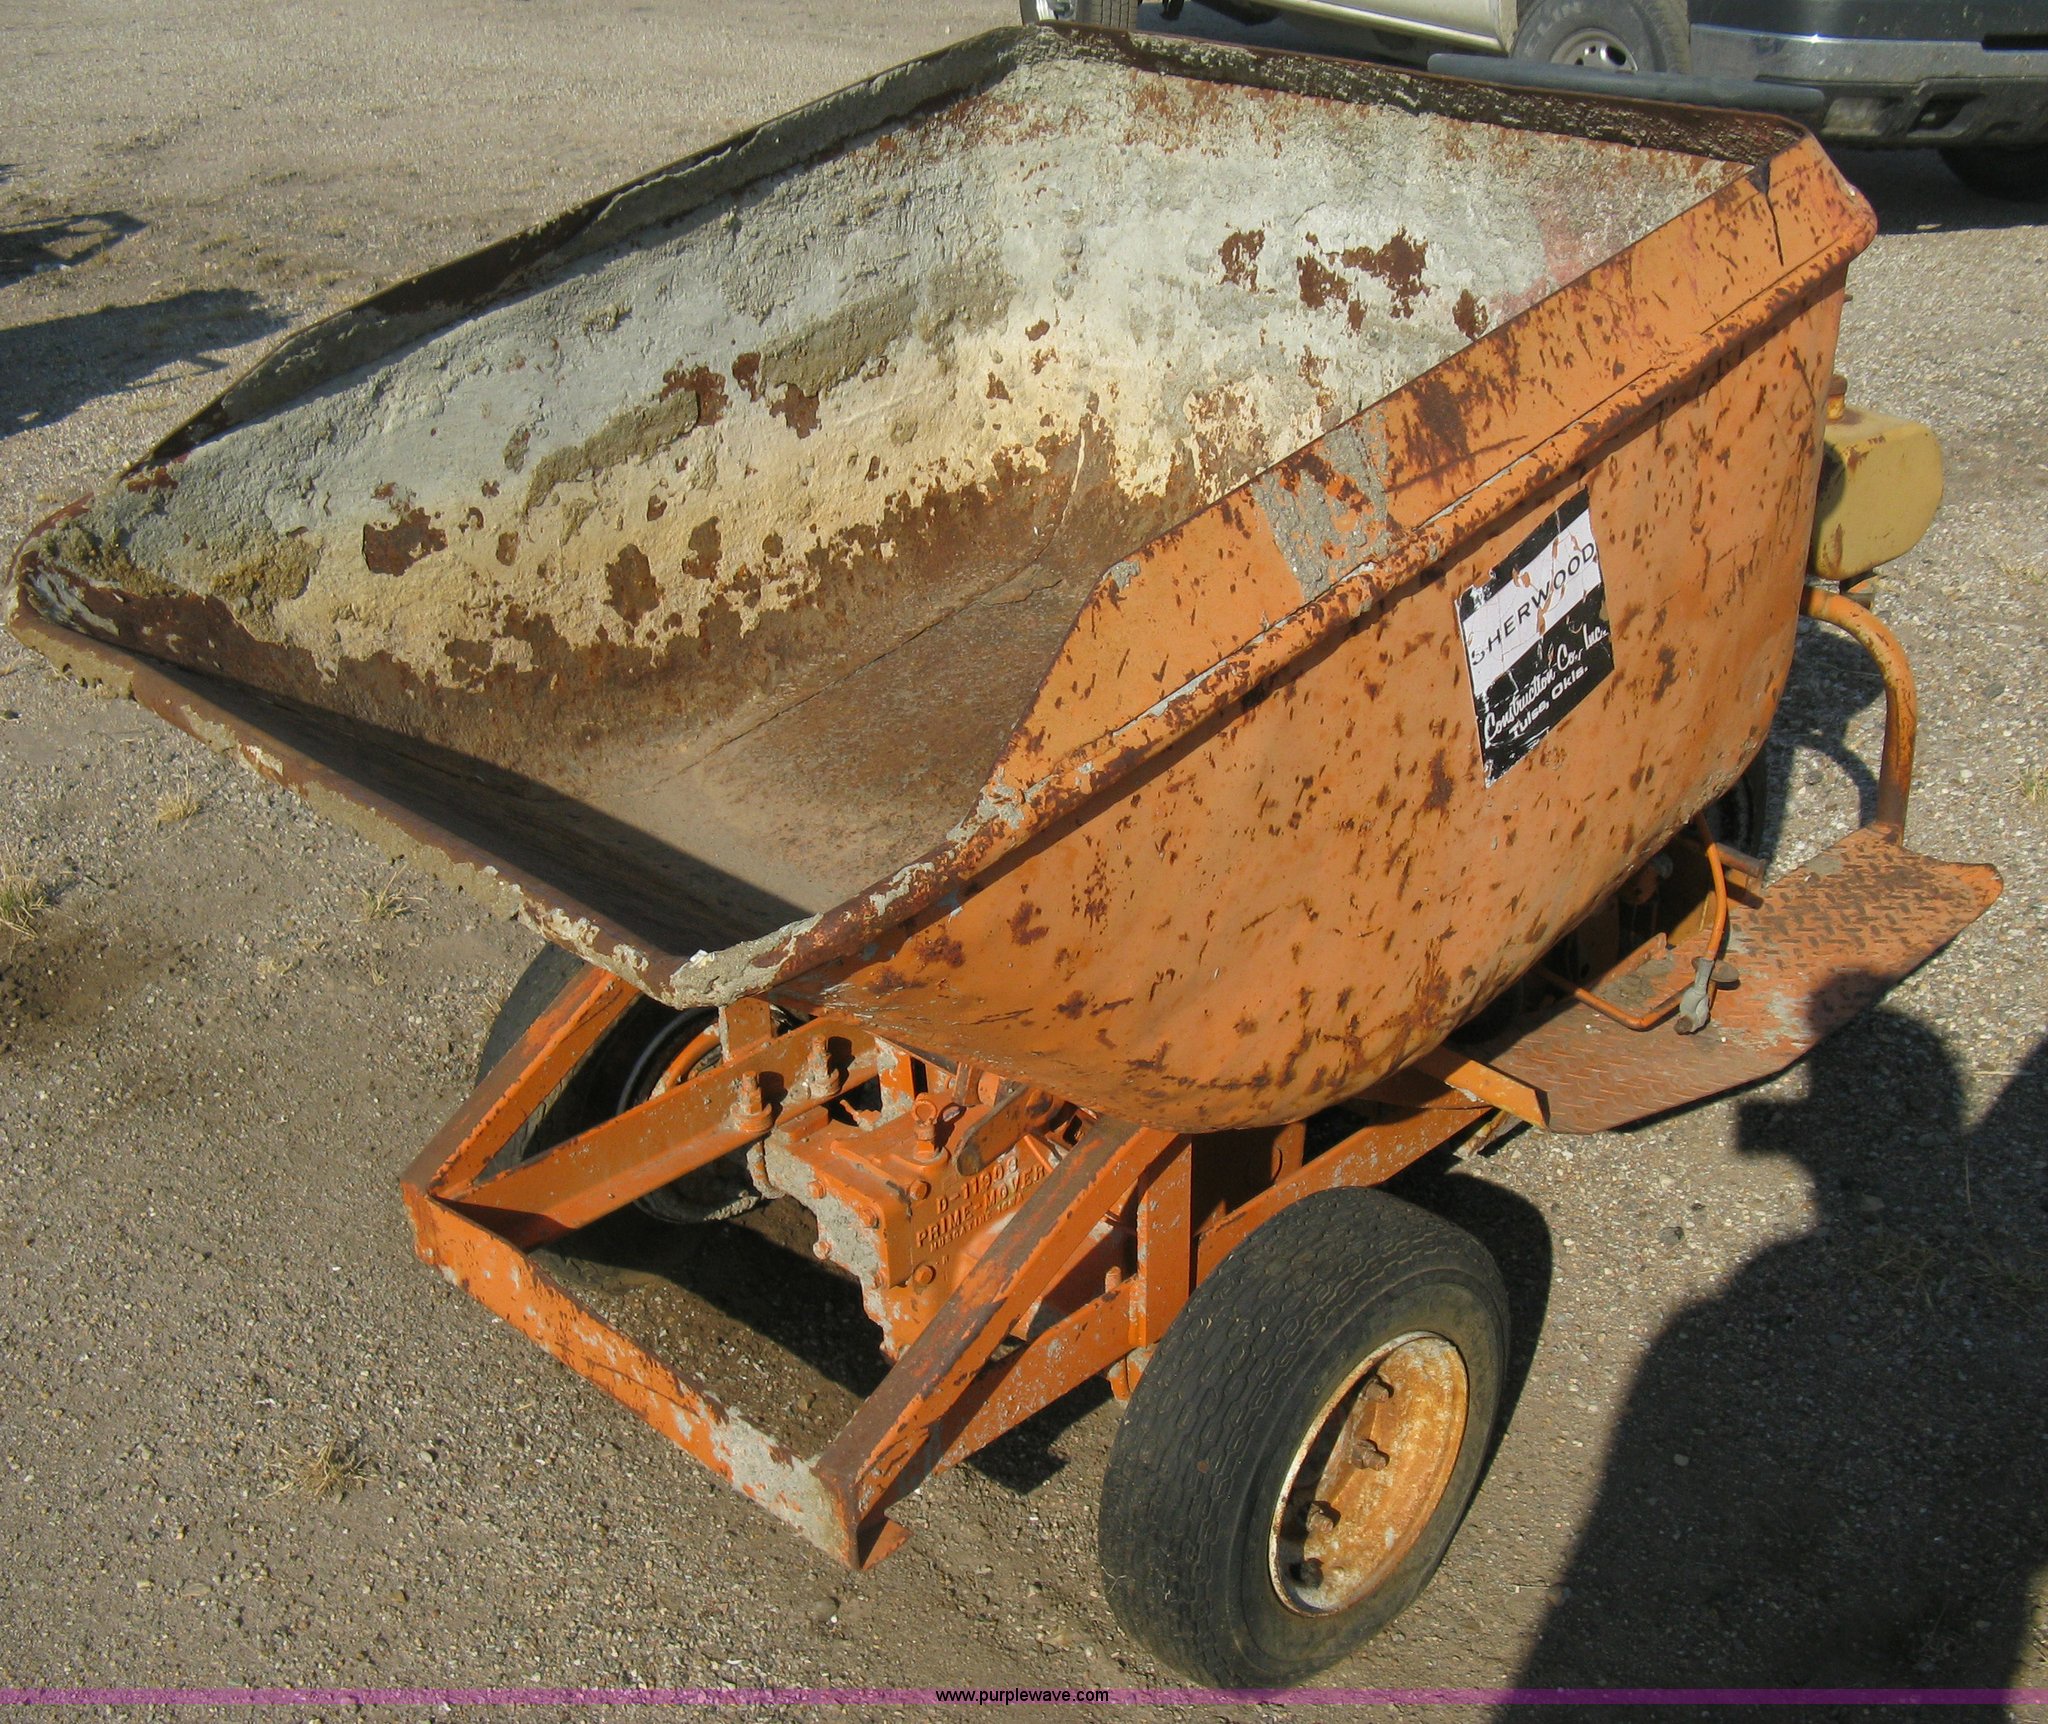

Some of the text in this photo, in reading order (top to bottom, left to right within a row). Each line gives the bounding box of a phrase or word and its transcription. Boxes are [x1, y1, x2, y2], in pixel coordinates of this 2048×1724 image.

[1471, 542, 1595, 666] SHERWOOD
[1483, 668, 1557, 742] Construction
[1582, 623, 1610, 651] Inc.
[1508, 666, 1589, 737] Tulsa, Okla.
[915, 1164, 1046, 1248] PRIME-MOVER
